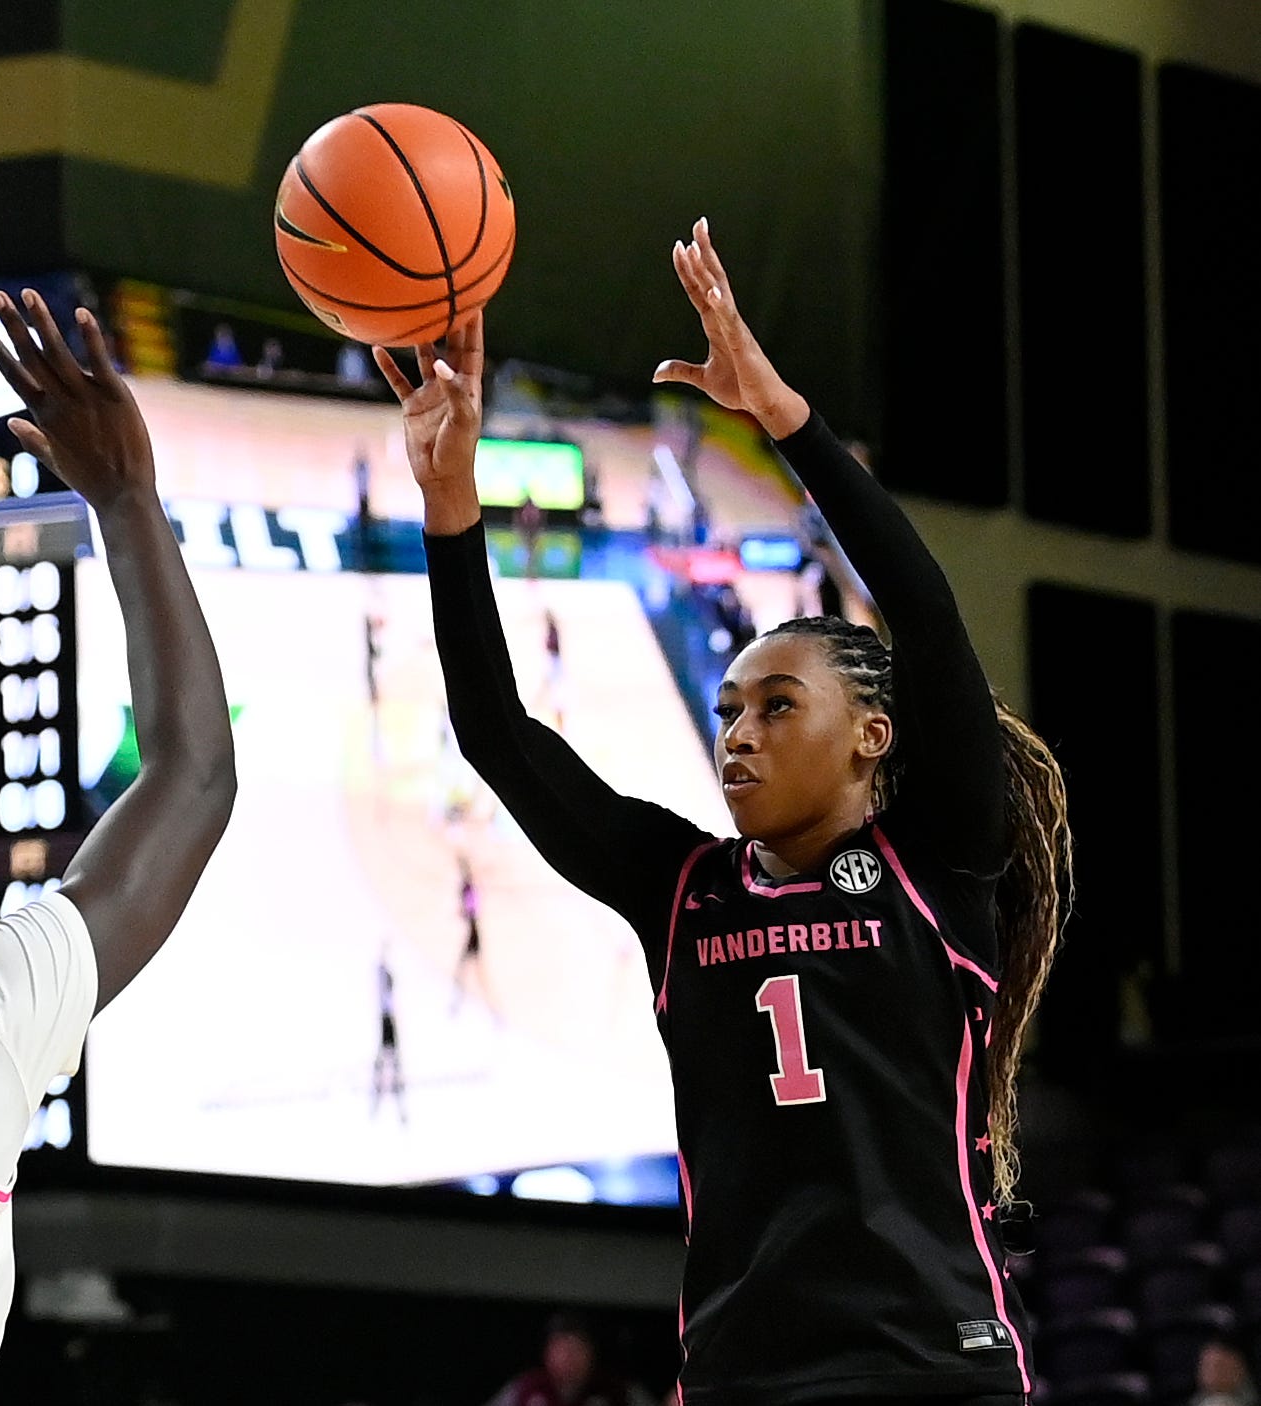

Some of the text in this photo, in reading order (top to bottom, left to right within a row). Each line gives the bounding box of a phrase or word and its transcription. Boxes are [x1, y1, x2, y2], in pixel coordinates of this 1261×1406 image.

[834, 853, 879, 891] SEC
[696, 919, 882, 967] VANDERBILT
[755, 974, 827, 1106] 1
